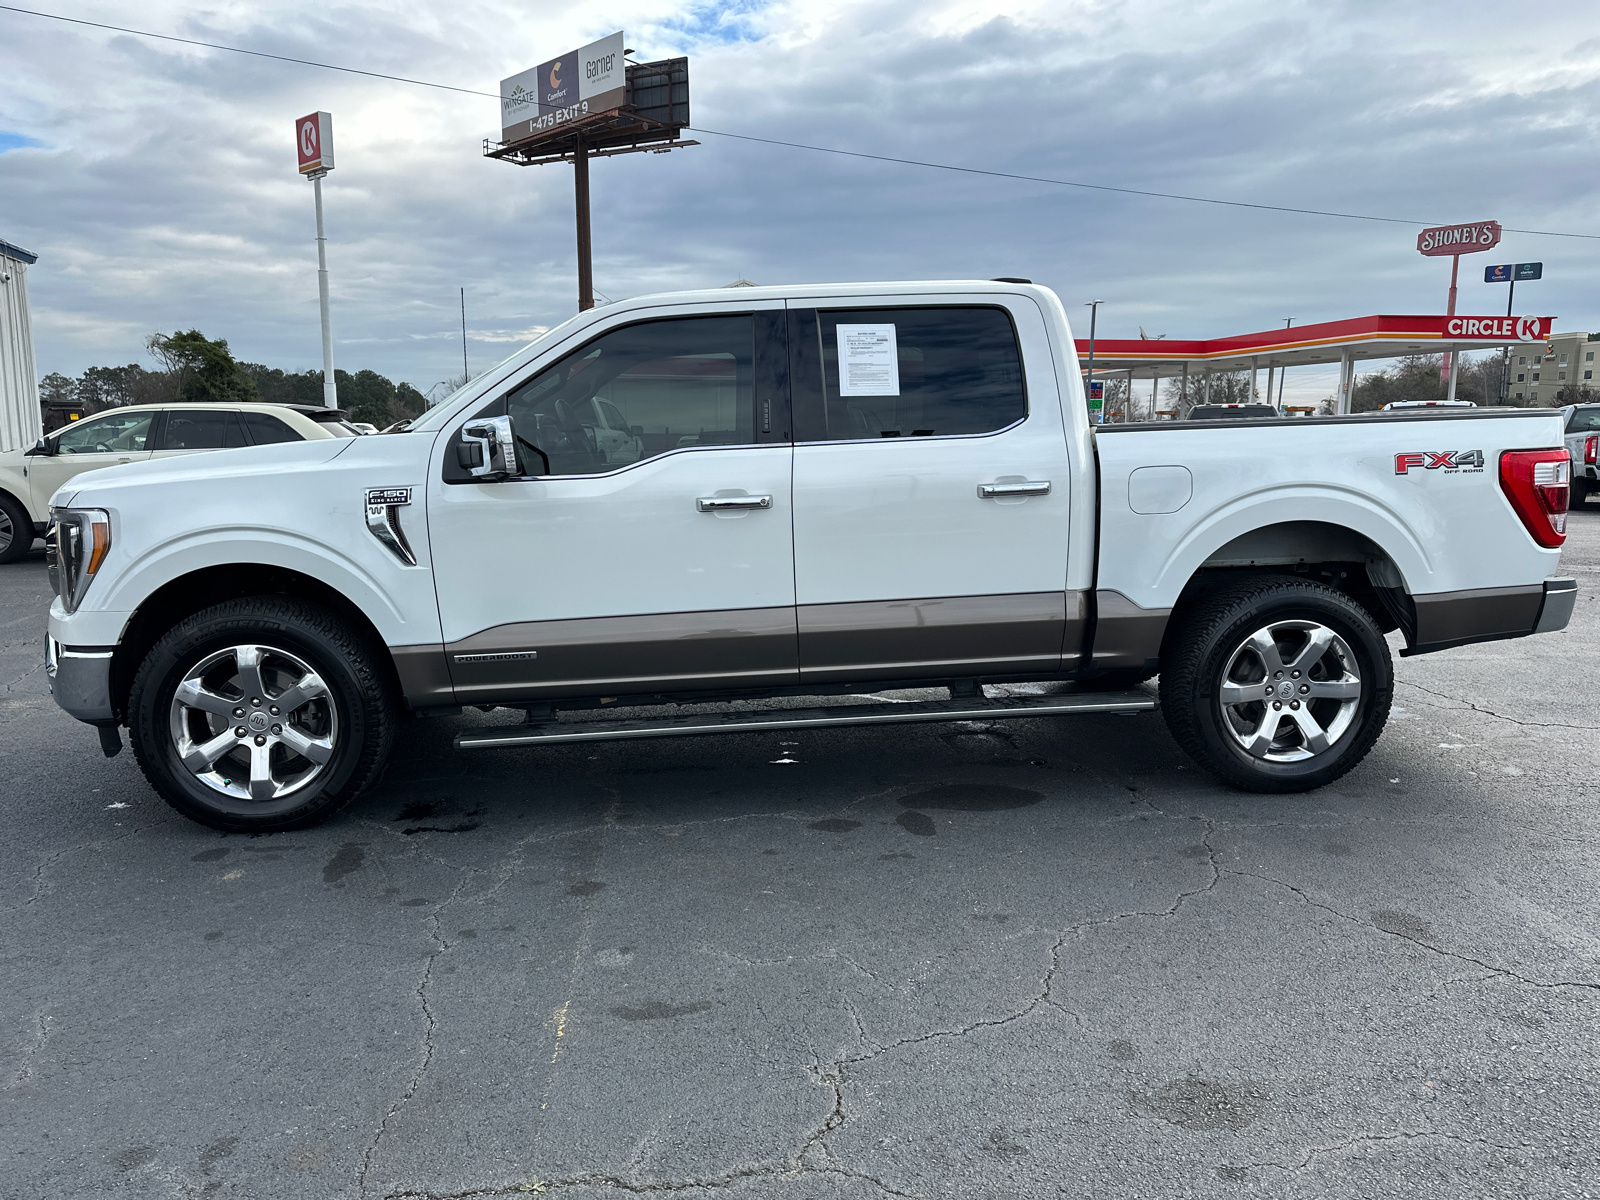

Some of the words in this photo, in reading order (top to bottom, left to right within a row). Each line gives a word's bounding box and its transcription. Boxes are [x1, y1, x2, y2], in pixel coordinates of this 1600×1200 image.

[586, 53, 615, 79] Garner
[503, 91, 534, 110] WINGATE
[547, 90, 567, 101] Comfort
[529, 113, 554, 132] I-475
[556, 103, 580, 124] EXIT
[582, 101, 588, 114] 9
[303, 125, 316, 153] K
[1420, 224, 1494, 251] SHONEY'S
[1447, 319, 1513, 335] CIRCLE
[1521, 319, 1538, 338] K
[1393, 449, 1485, 476] FX4
[369, 490, 407, 499] F-150
[458, 653, 533, 662] POWERBOOST
